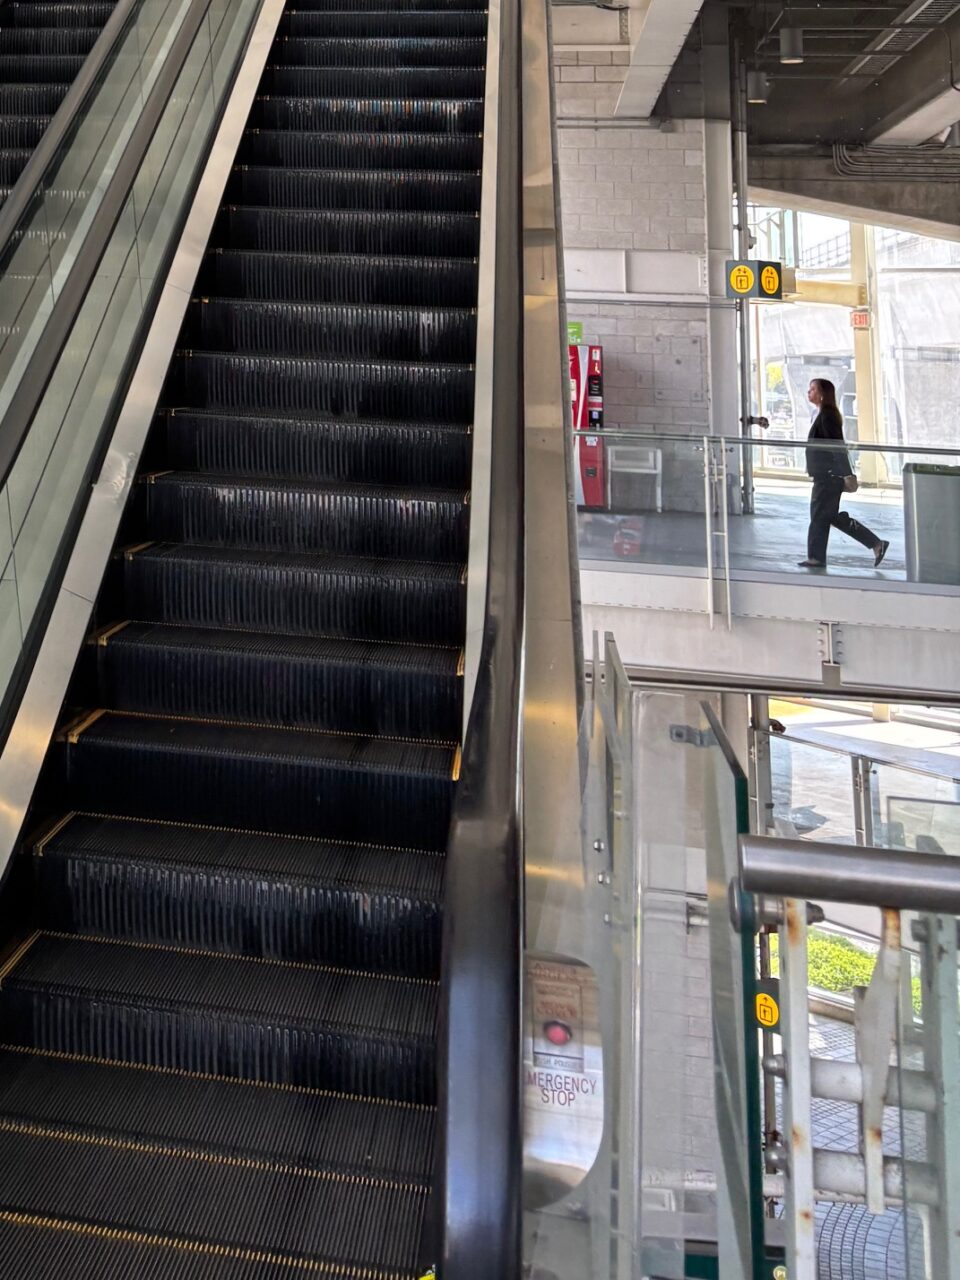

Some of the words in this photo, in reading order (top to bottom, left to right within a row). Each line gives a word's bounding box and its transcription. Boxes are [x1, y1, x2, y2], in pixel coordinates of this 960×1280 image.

[853, 313, 868, 326] EXIT
[525, 1070, 597, 1095] MERGENCY
[541, 1087, 576, 1107] STOP
